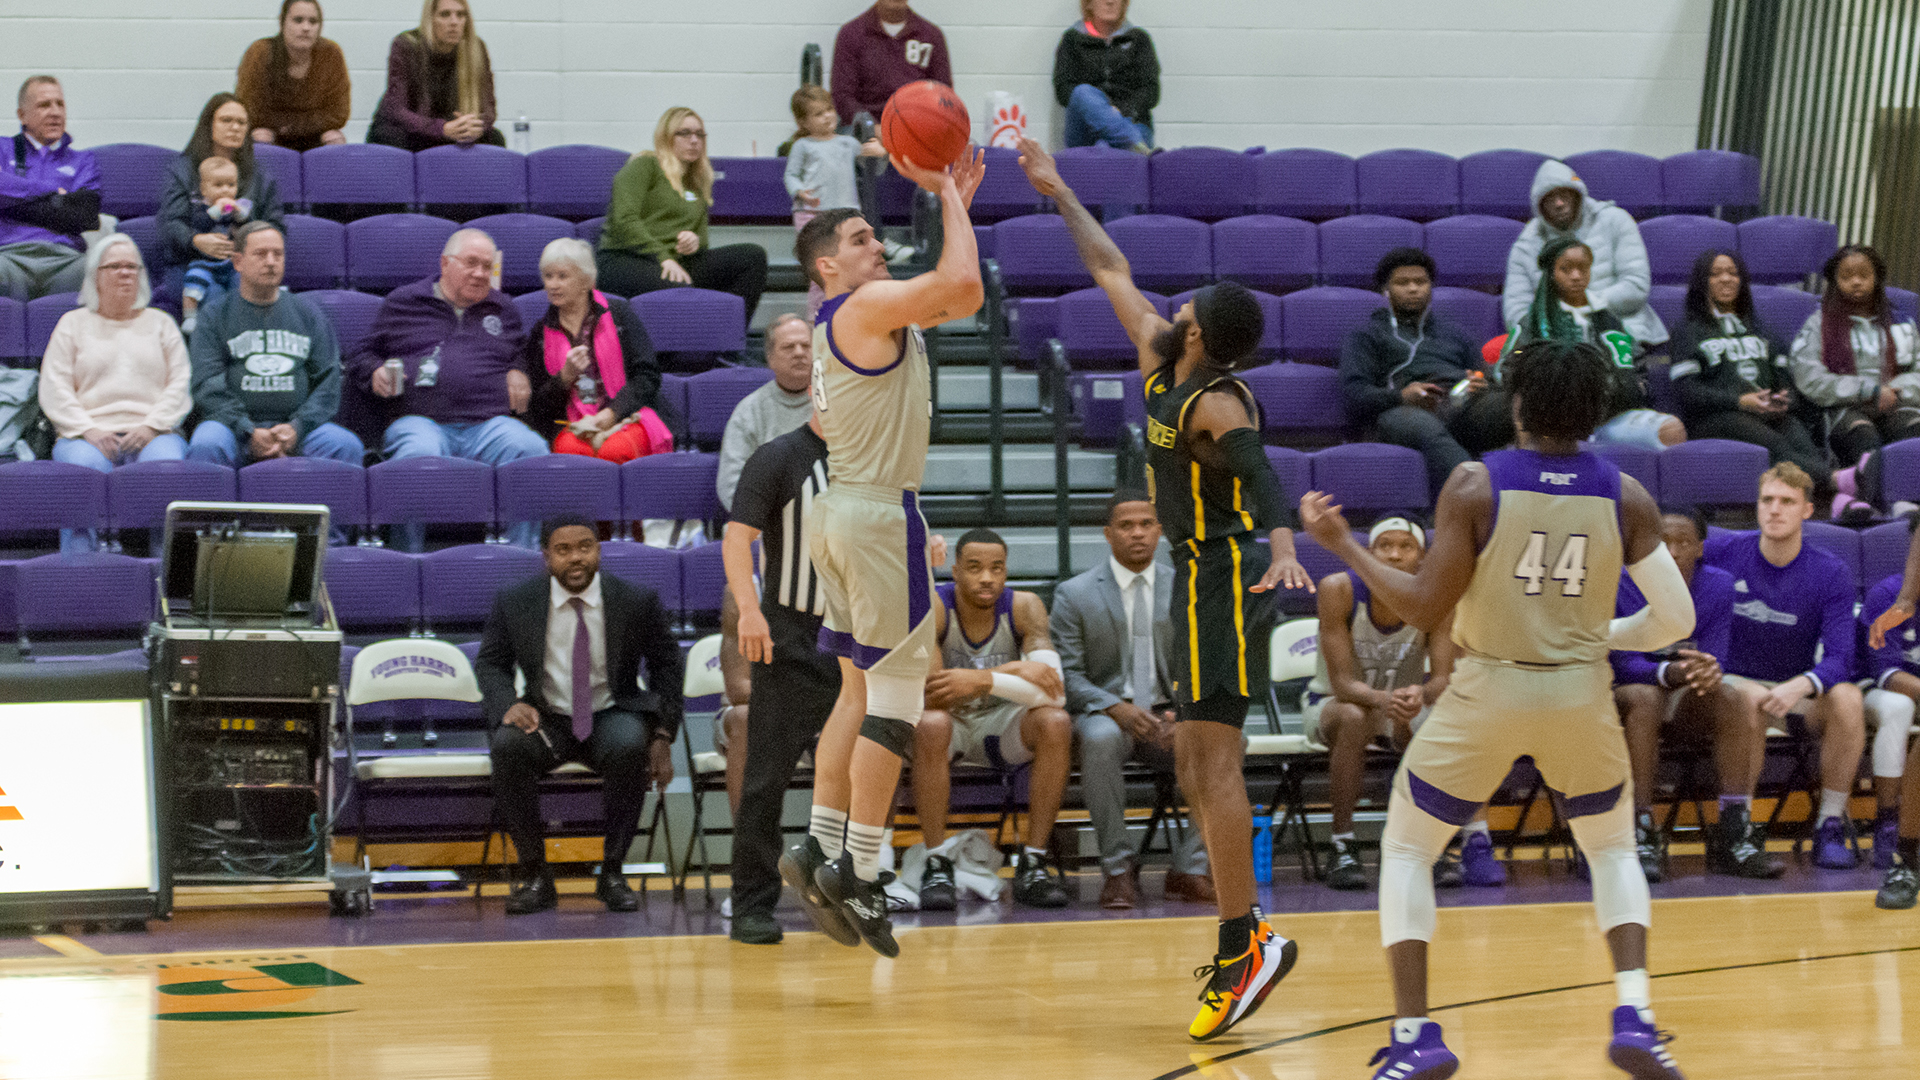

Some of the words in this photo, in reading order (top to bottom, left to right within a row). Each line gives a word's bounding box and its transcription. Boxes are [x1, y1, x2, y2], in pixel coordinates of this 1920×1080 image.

[906, 39, 933, 67] 87
[227, 330, 264, 358] YOUNG
[266, 329, 311, 359] HARRIS
[241, 375, 295, 392] COLLEGE
[1514, 530, 1588, 598] 44
[371, 656, 407, 678] YOUNG
[409, 655, 457, 678] HARRIS
